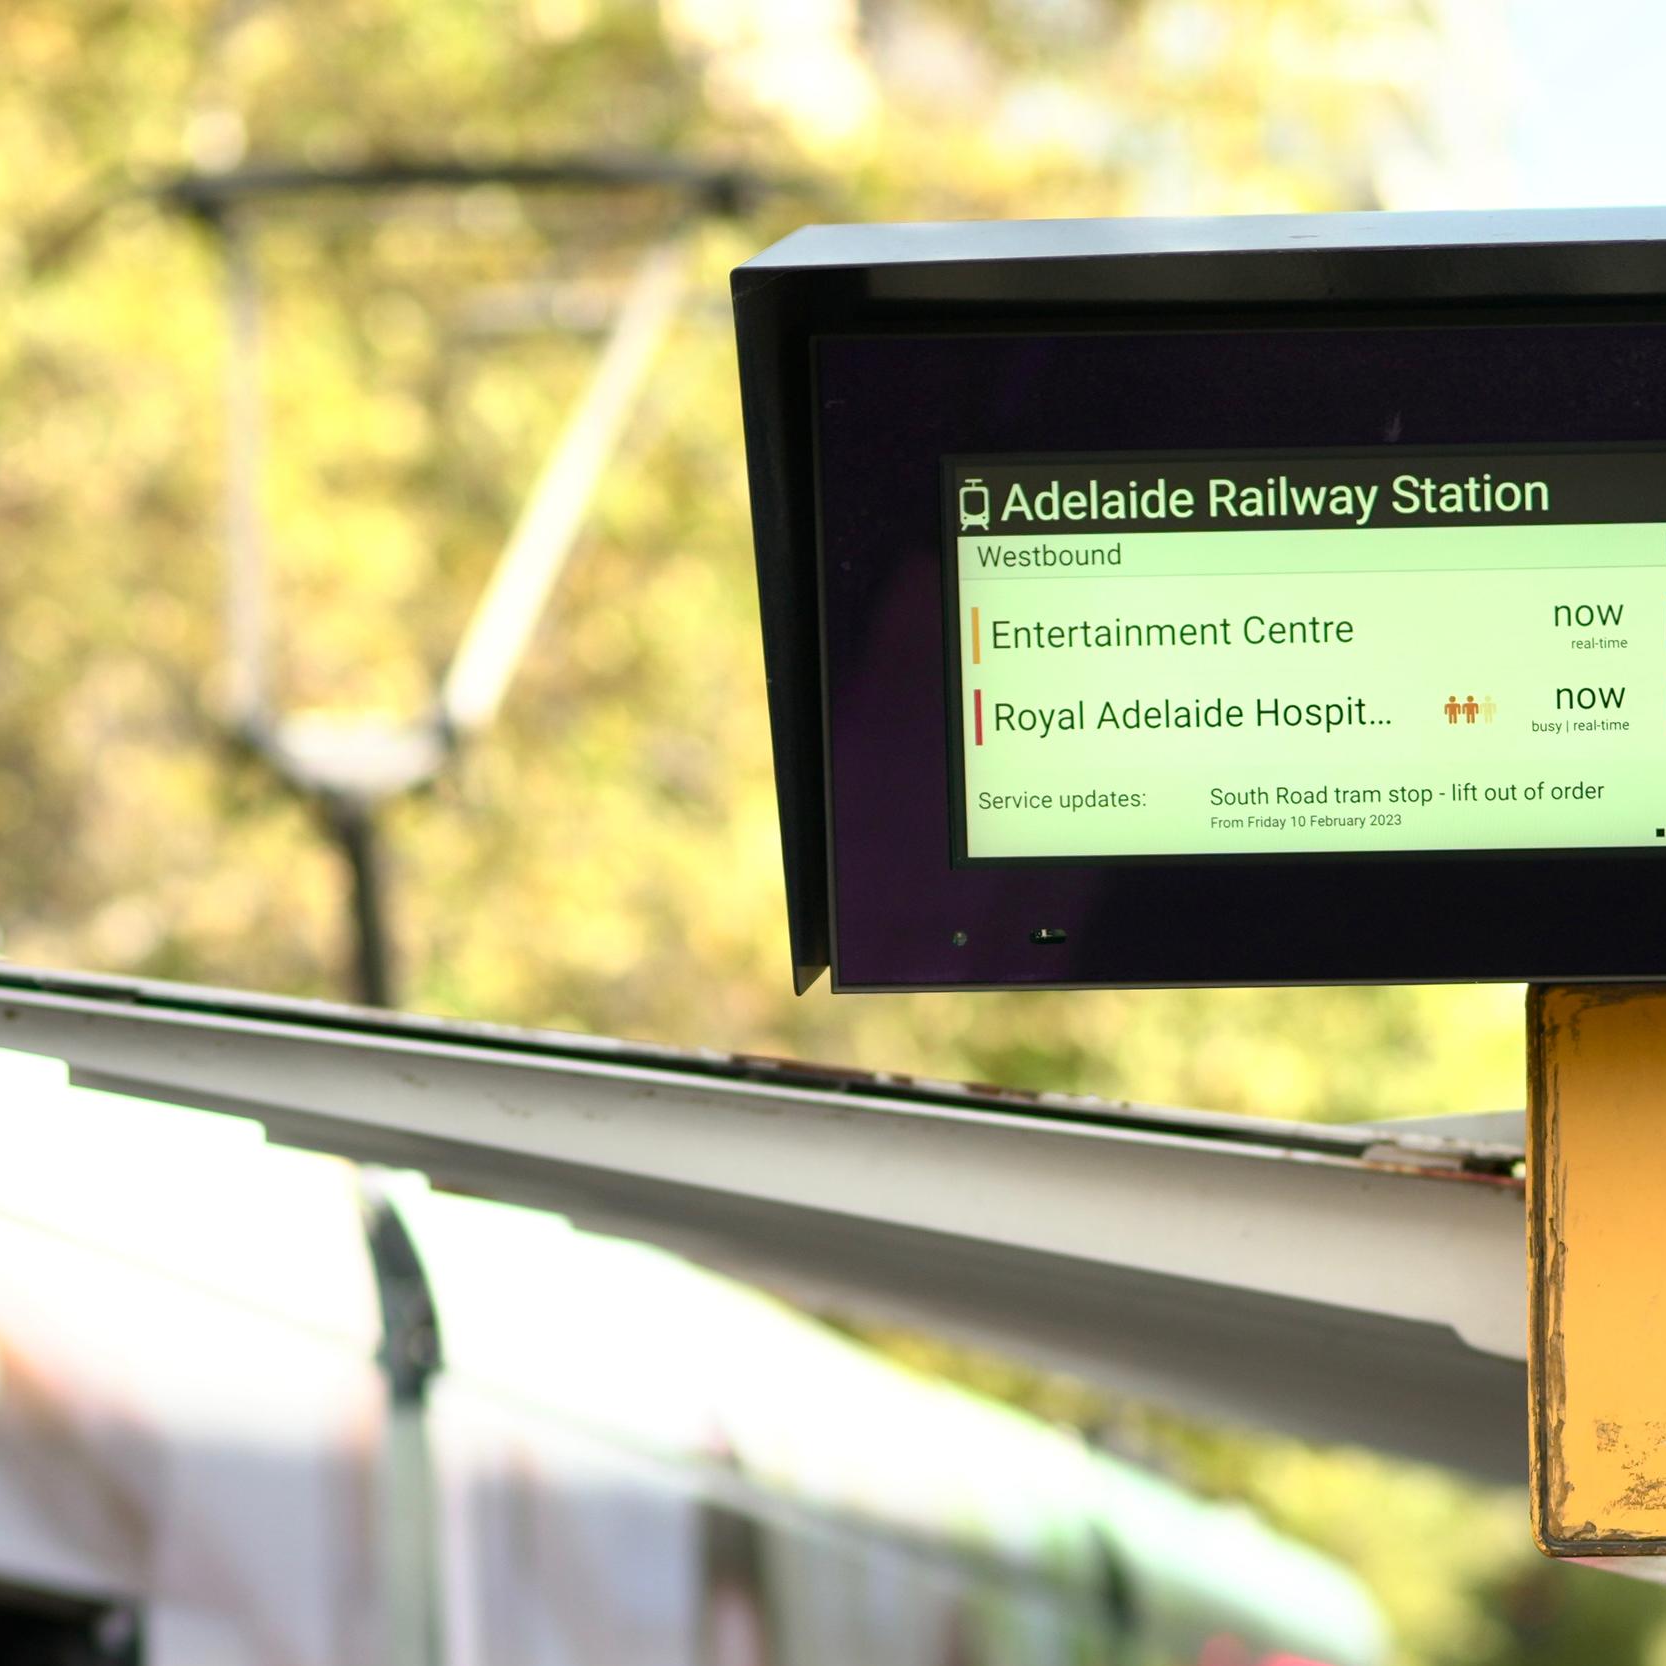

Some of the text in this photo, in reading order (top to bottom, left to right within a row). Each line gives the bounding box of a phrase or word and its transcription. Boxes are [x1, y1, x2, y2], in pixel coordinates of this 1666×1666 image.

[1000, 473, 1549, 526] Adelaide Railway Station
[976, 542, 1122, 568] Westbound
[1554, 604, 1624, 627] now
[992, 615, 1354, 649] Entertainment Centre
[1571, 637, 1629, 650] real-time
[1556, 686, 1626, 710] now
[995, 700, 1084, 739] Royal
[1096, 697, 1244, 730] Adelaide
[1531, 720, 1563, 735] busy
[1573, 719, 1630, 732] real-time
[978, 789, 1147, 813] Service updates:
[1210, 786, 1269, 806] South
[1276, 785, 1328, 805] Road
[1333, 787, 1381, 804] tram
[1388, 786, 1433, 807] stop
[1452, 782, 1478, 802] lift
[1484, 784, 1518, 802] out
[1523, 780, 1545, 801] of
[1550, 780, 1605, 800] order
[1210, 813, 1402, 831] From Friday 10 February 2023
